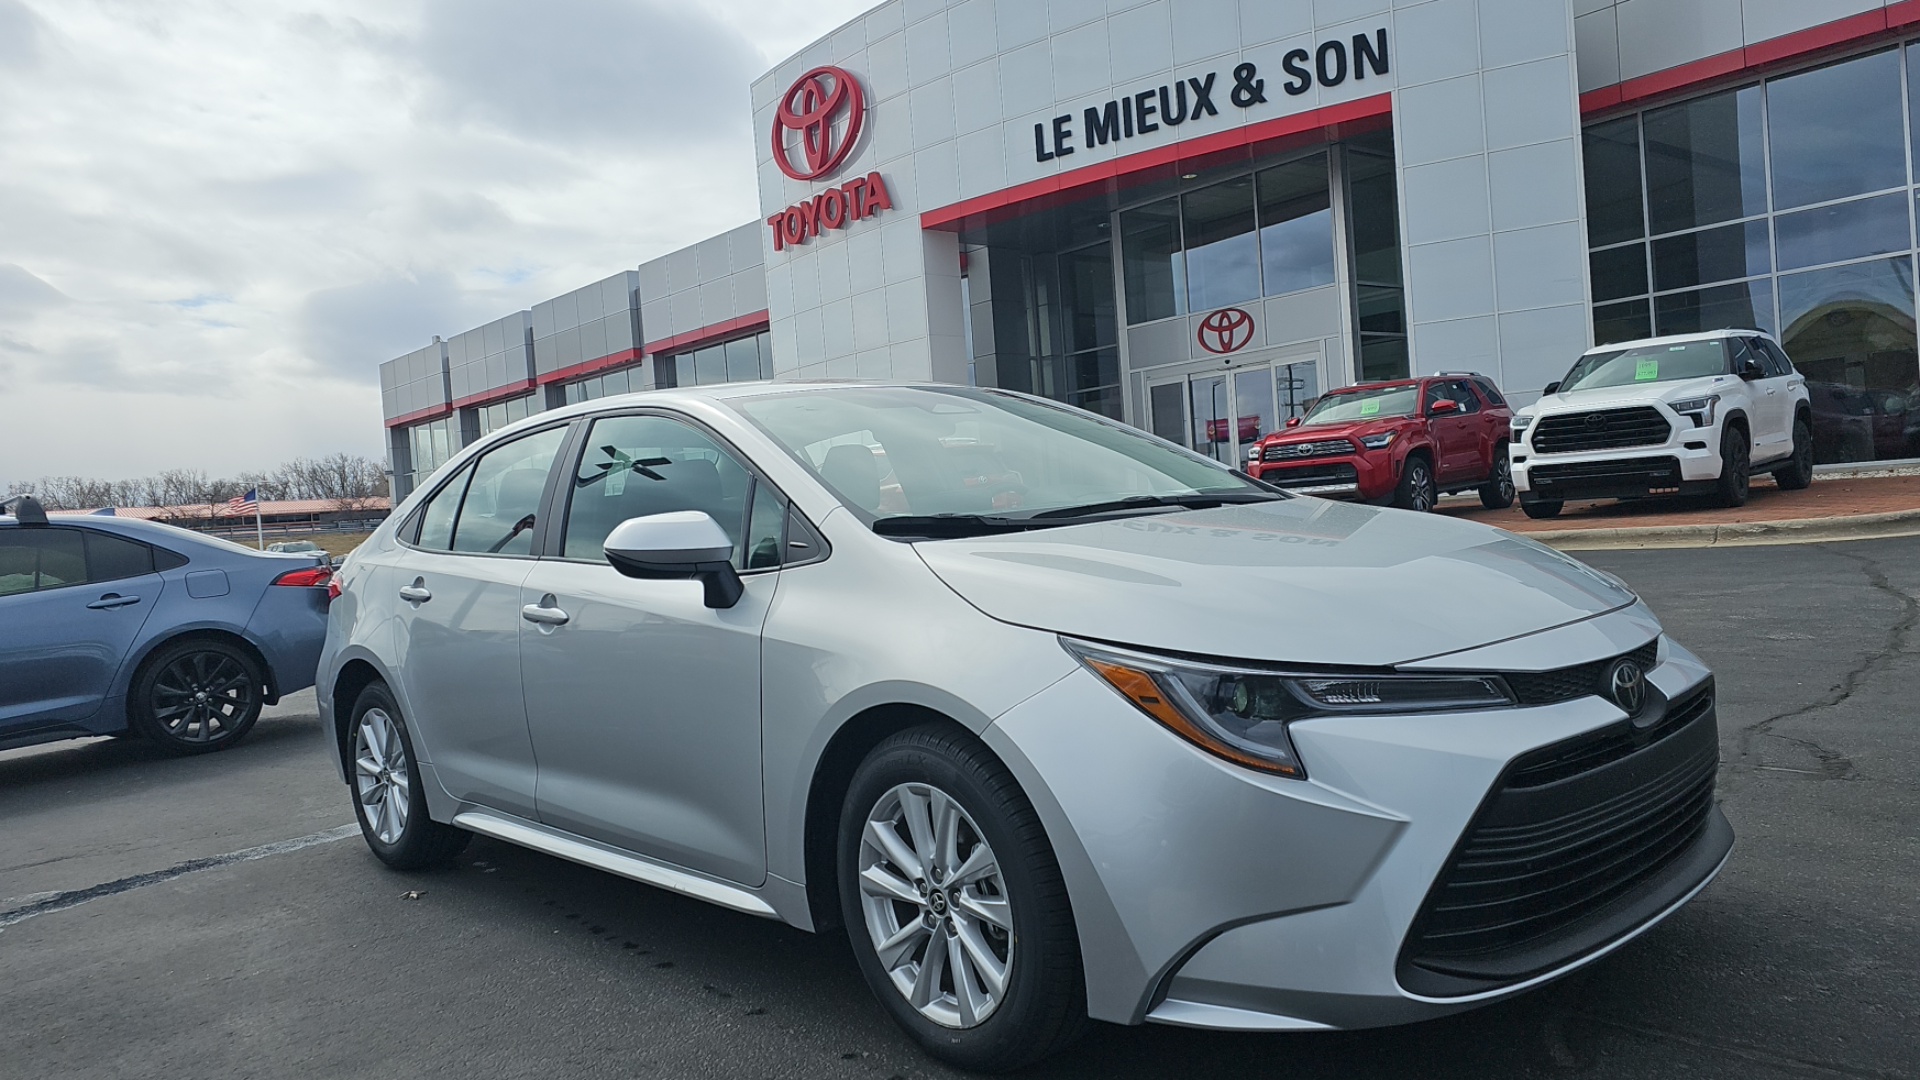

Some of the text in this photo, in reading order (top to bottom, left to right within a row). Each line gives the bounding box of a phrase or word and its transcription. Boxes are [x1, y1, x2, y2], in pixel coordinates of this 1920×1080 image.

[1034, 27, 1390, 163] LE MIEUX & SON
[767, 171, 892, 251] TOYOTA
